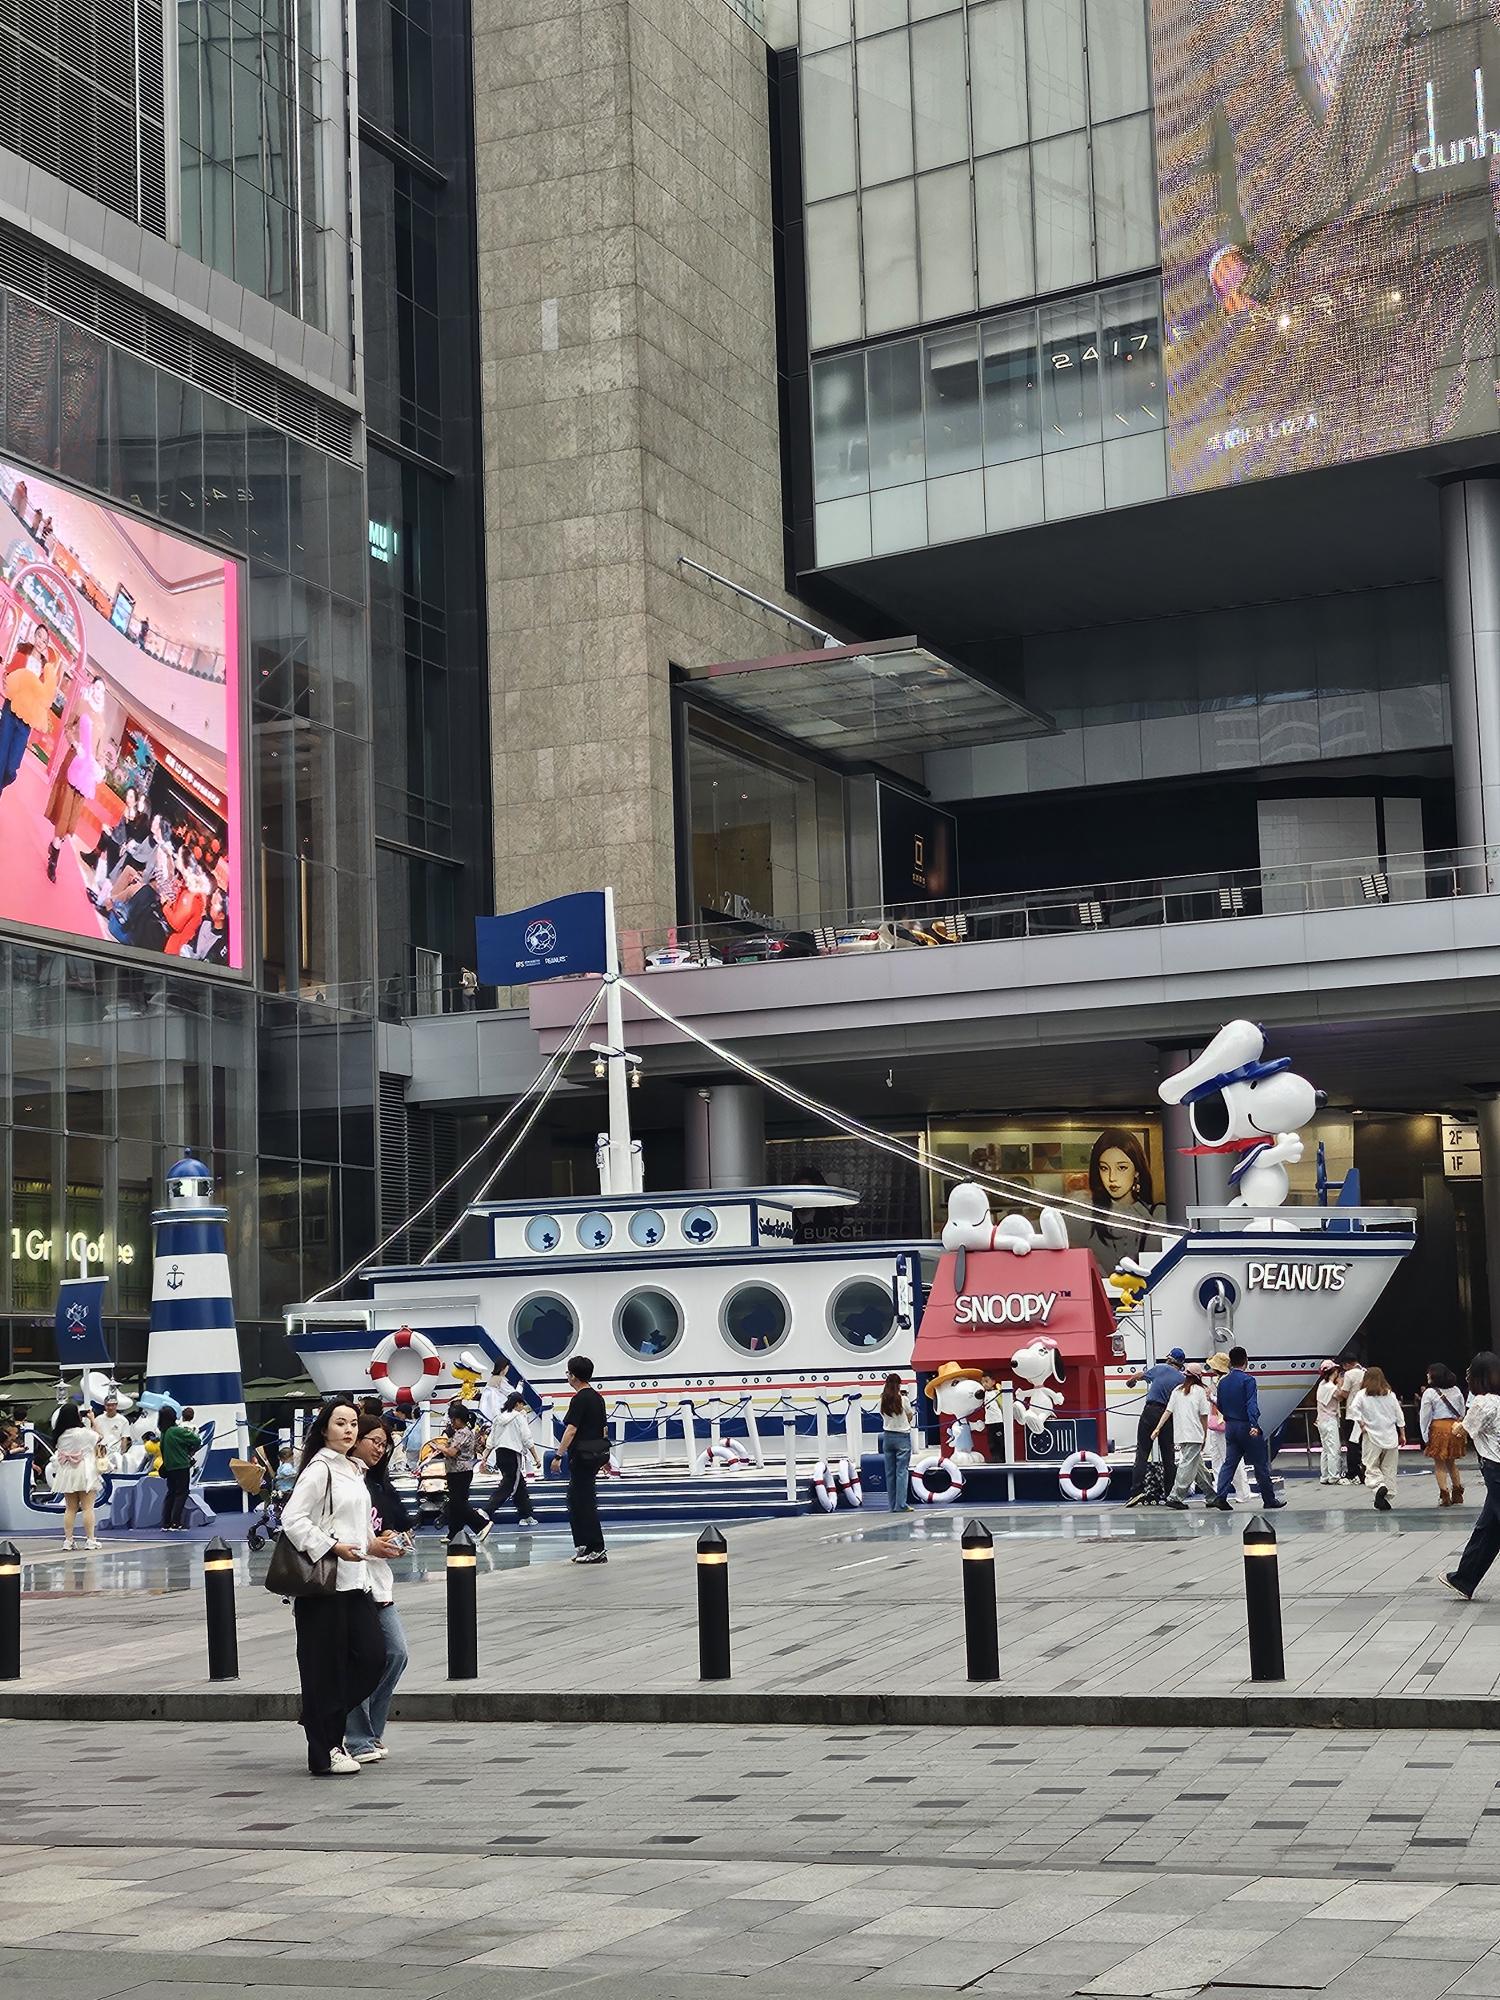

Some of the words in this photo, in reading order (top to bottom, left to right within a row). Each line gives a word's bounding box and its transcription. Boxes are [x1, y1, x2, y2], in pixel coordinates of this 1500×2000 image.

[368, 519, 398, 555] MUI
[1449, 1130, 1462, 1145] 2F
[1451, 1156, 1463, 1170] 1F
[804, 1226, 864, 1240] BURCH
[1247, 1262, 1347, 1291] PEANUTS
[954, 1291, 1058, 1324] SNOOPY
